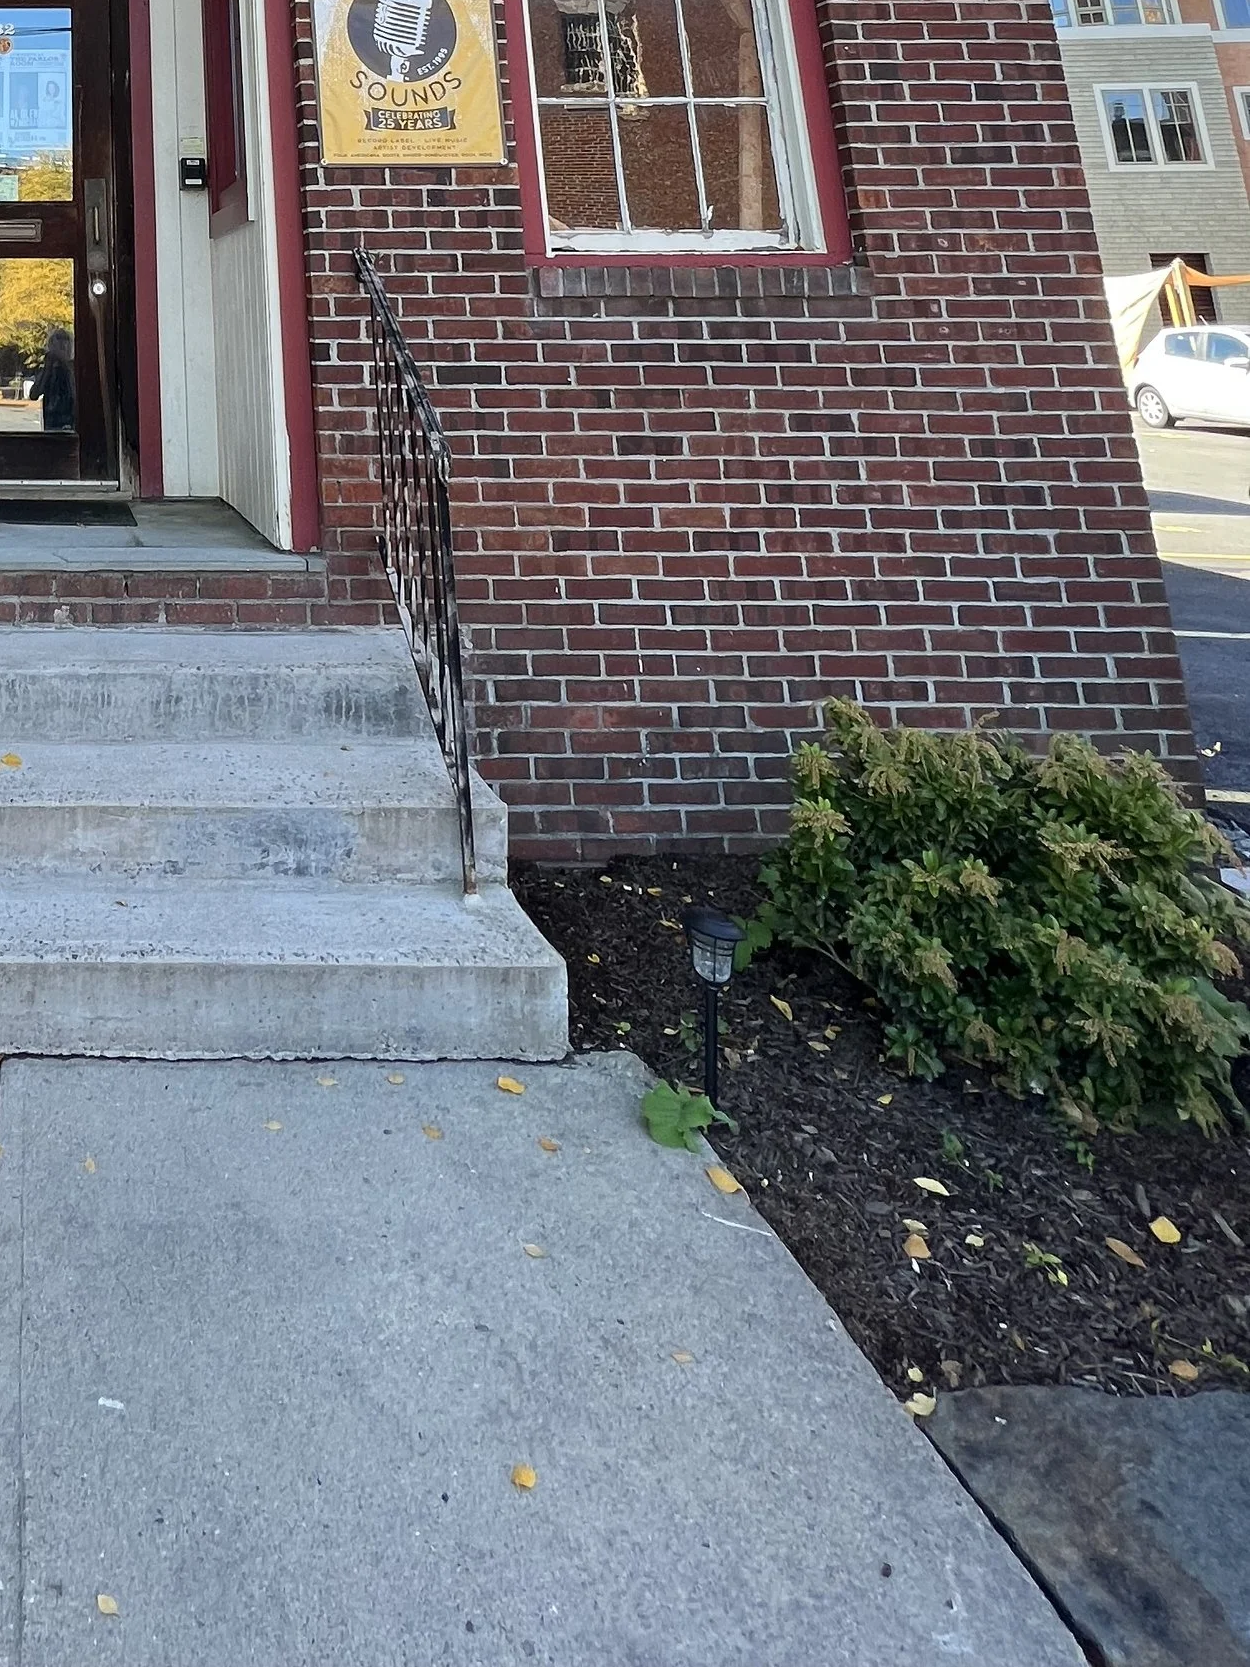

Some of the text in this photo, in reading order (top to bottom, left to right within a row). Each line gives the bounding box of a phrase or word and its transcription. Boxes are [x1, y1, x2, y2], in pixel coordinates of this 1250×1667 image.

[417, 47, 449, 76] EST. 1995
[349, 70, 462, 107] SOUNDS
[378, 110, 441, 120] CELEBRATING
[378, 119, 442, 130] 25 YEARS
